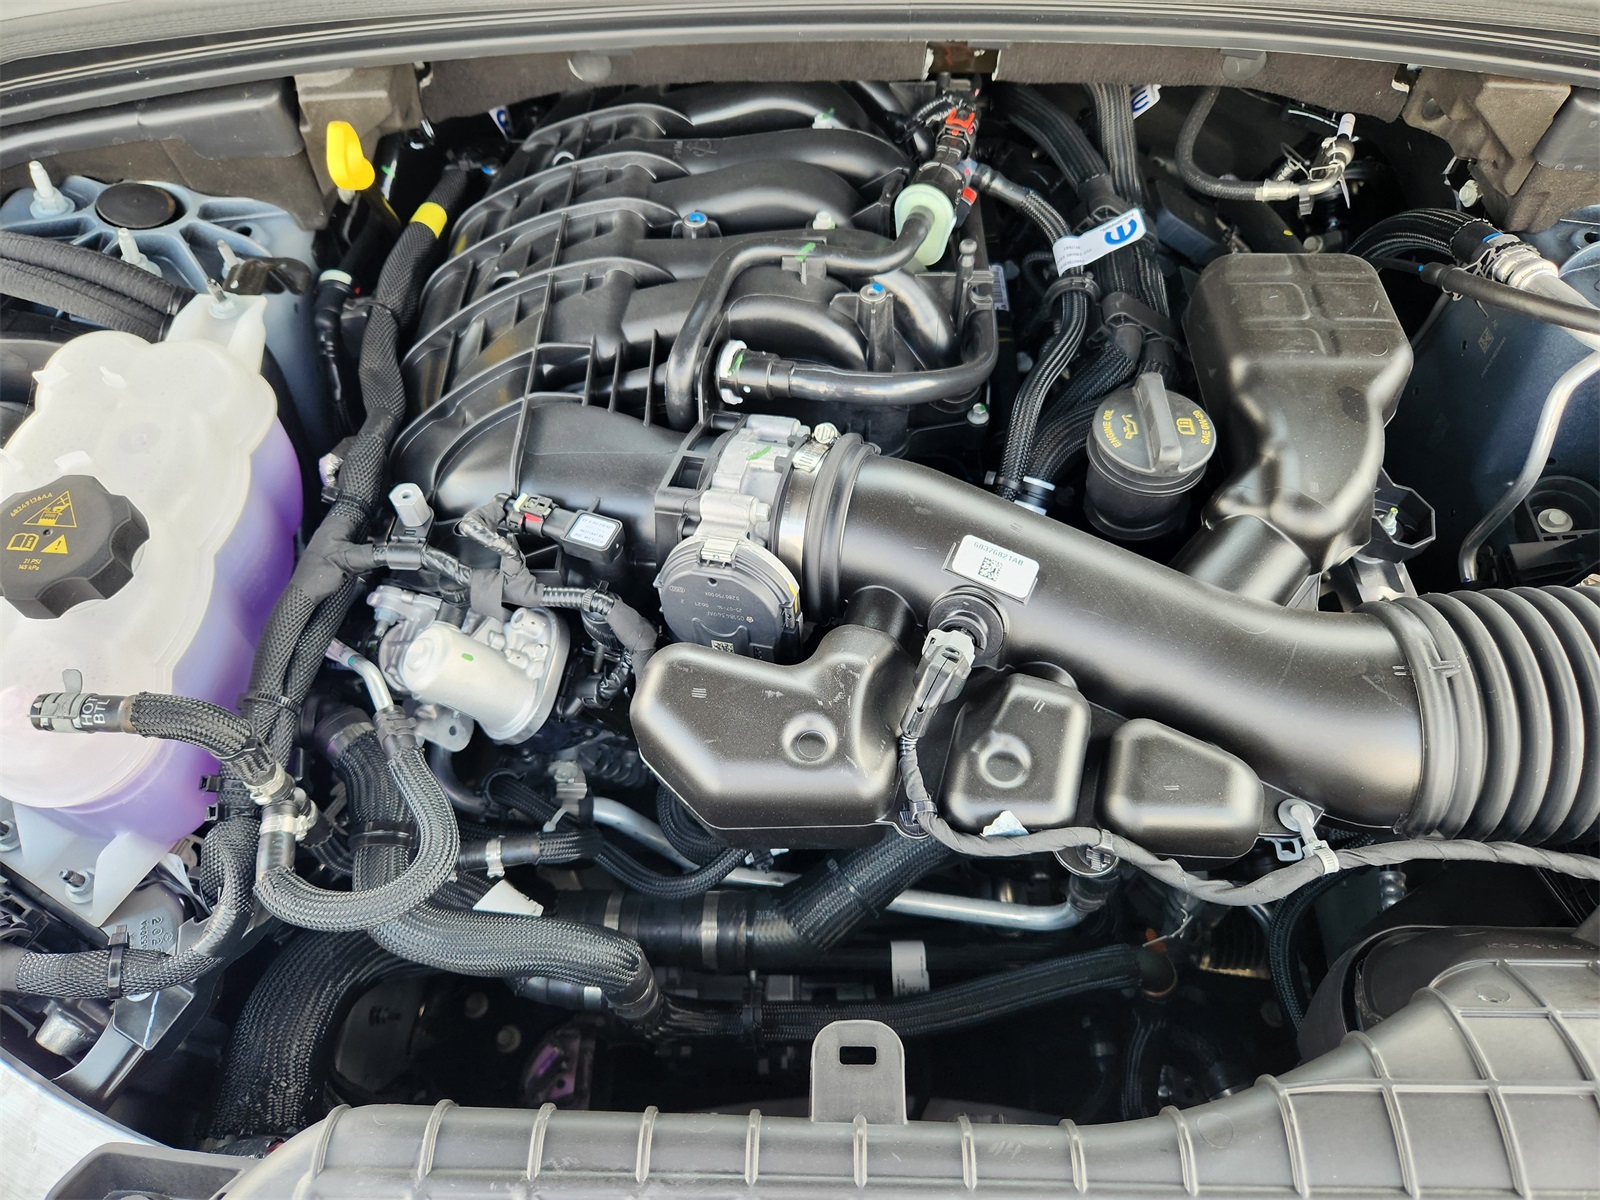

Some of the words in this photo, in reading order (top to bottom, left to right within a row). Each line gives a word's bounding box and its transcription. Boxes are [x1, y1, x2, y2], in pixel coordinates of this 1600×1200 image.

[1103, 409, 1115, 420] OIL
[1102, 421, 1122, 448] ENGINE
[1201, 429, 1211, 445] SAE
[9, 492, 53, 517] 68249136AA
[973, 541, 1024, 566] 68376821AB
[81, 696, 99, 726] HOT
[93, 698, 111, 725] BTL
